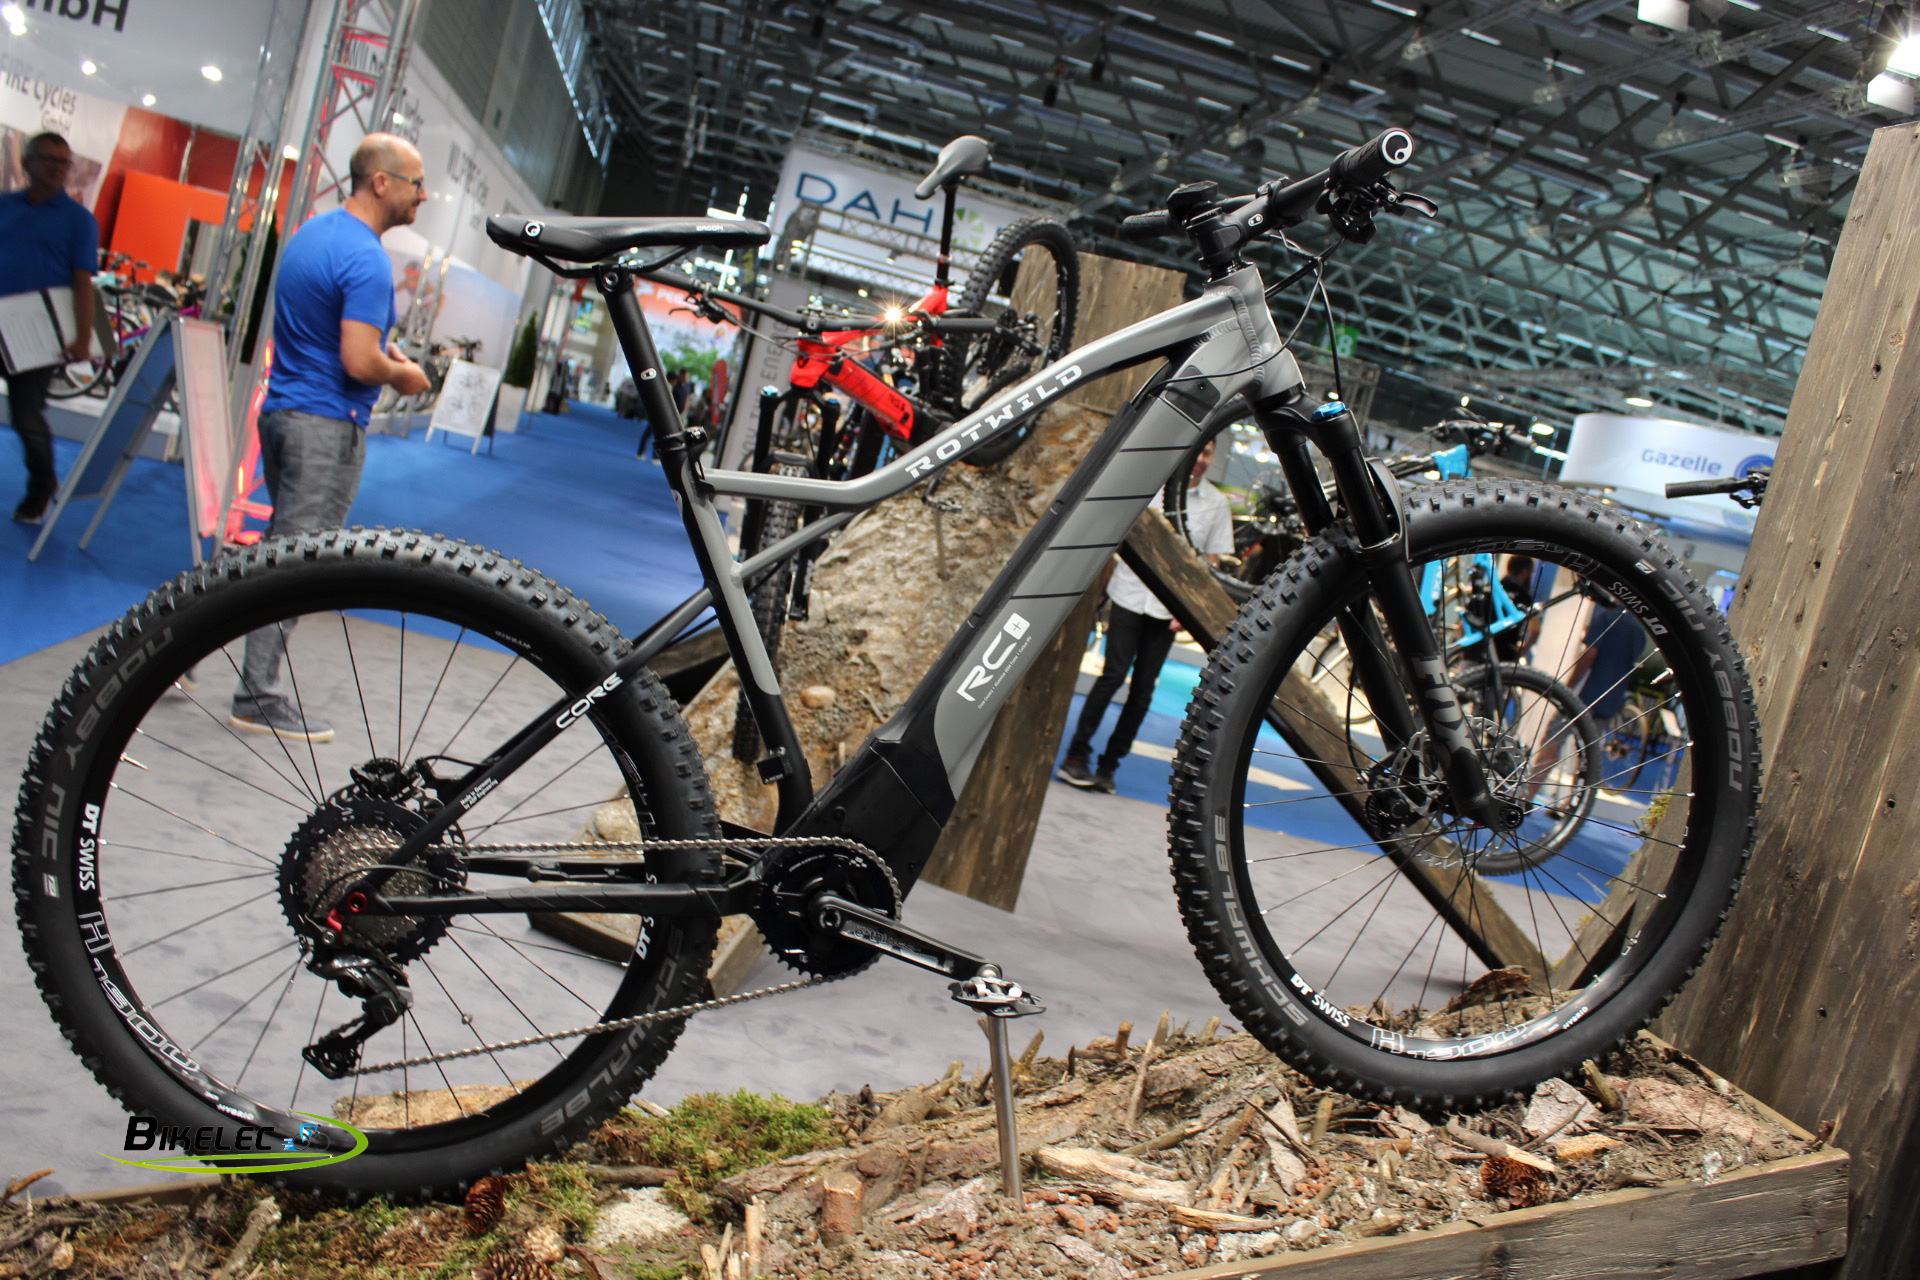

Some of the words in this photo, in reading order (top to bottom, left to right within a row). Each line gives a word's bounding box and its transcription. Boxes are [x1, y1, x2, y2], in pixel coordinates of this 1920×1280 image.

[34, 70, 77, 116] Cycles
[905, 365, 1082, 479] ROTWILD
[1641, 448, 1722, 476] Gazelle
[1608, 580, 1649, 615] SWISS
[1656, 578, 1707, 632] NIC
[1645, 616, 1668, 636] DT
[65, 625, 174, 771] NOBBY
[556, 672, 623, 729] CORE
[1703, 646, 1743, 792] NOBBY
[42, 782, 66, 861] NIC
[82, 802, 101, 835] DT
[79, 837, 96, 891] SWISS
[1214, 814, 1310, 1027] SCHWALBE
[1290, 973, 1314, 996] DT
[1311, 992, 1352, 1029] SWISS
